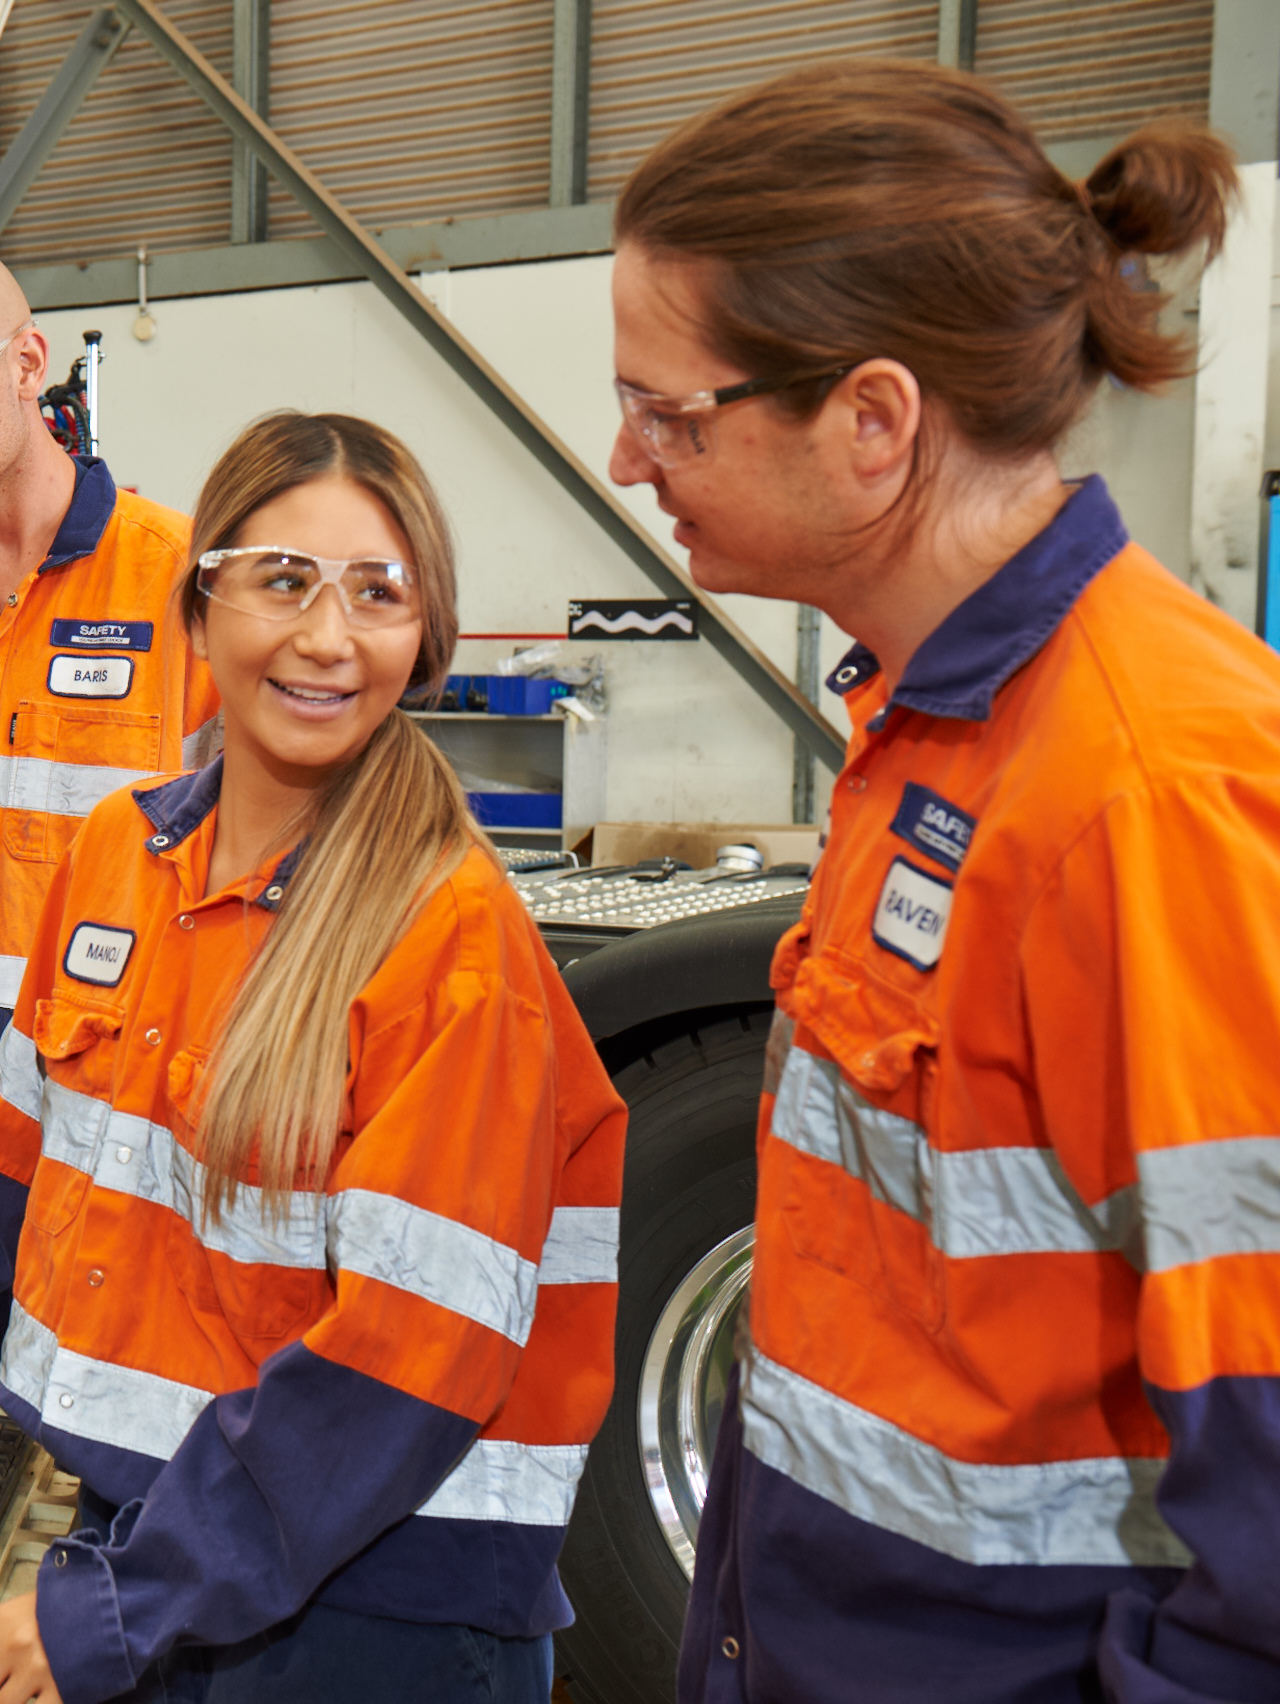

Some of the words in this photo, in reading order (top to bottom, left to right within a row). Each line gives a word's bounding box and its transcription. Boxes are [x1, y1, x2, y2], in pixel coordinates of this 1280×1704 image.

[79, 624, 126, 636] SAFETY
[74, 670, 108, 682] BARIS
[920, 802, 971, 845] SAFE
[86, 942, 122, 963] MANOJ
